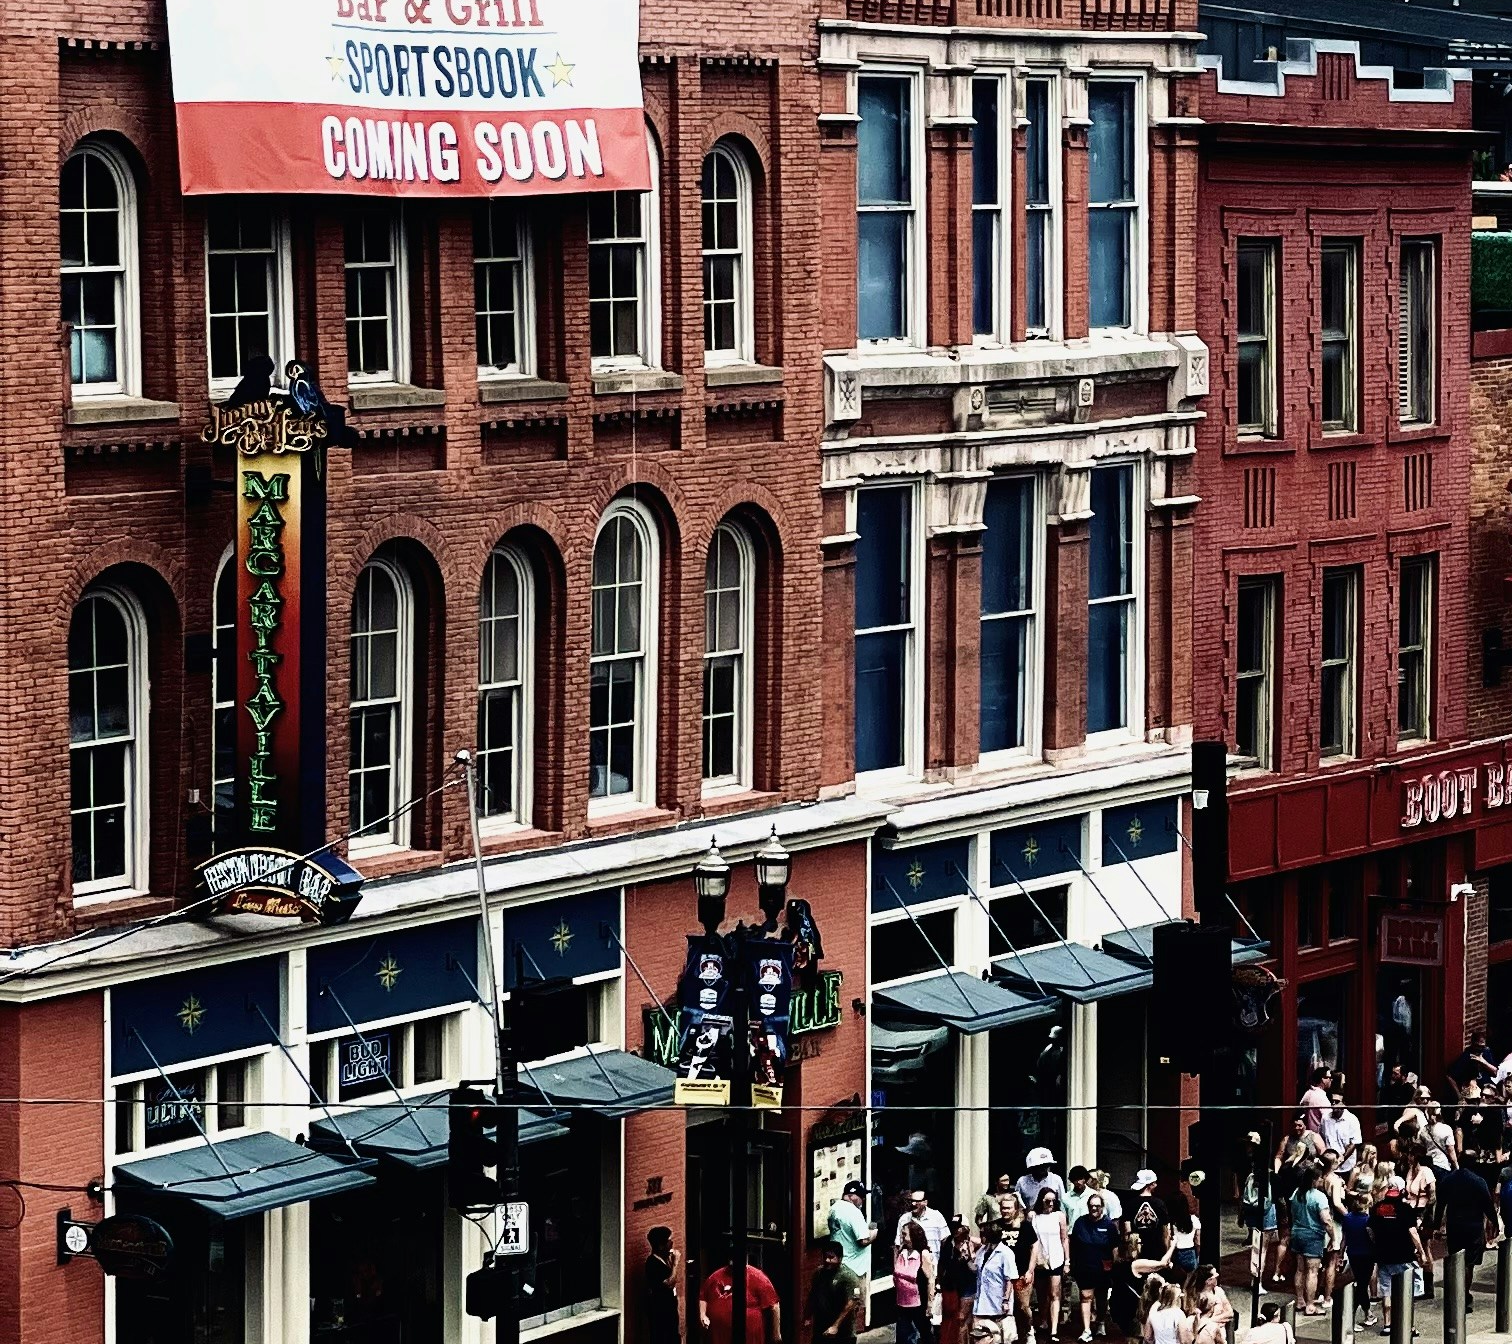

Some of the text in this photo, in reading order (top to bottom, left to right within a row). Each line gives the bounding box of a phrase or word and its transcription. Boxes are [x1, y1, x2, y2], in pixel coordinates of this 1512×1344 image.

[345, 40, 545, 98] SPORTSBOOK
[321, 115, 604, 182] COMING SOON
[243, 470, 290, 833] MARGARITAVILLE
[1401, 767, 1477, 828] BOOT
[342, 1056, 388, 1083] LIGHT
[349, 1039, 381, 1062] BUD
[147, 1096, 202, 1125] ULTRA
